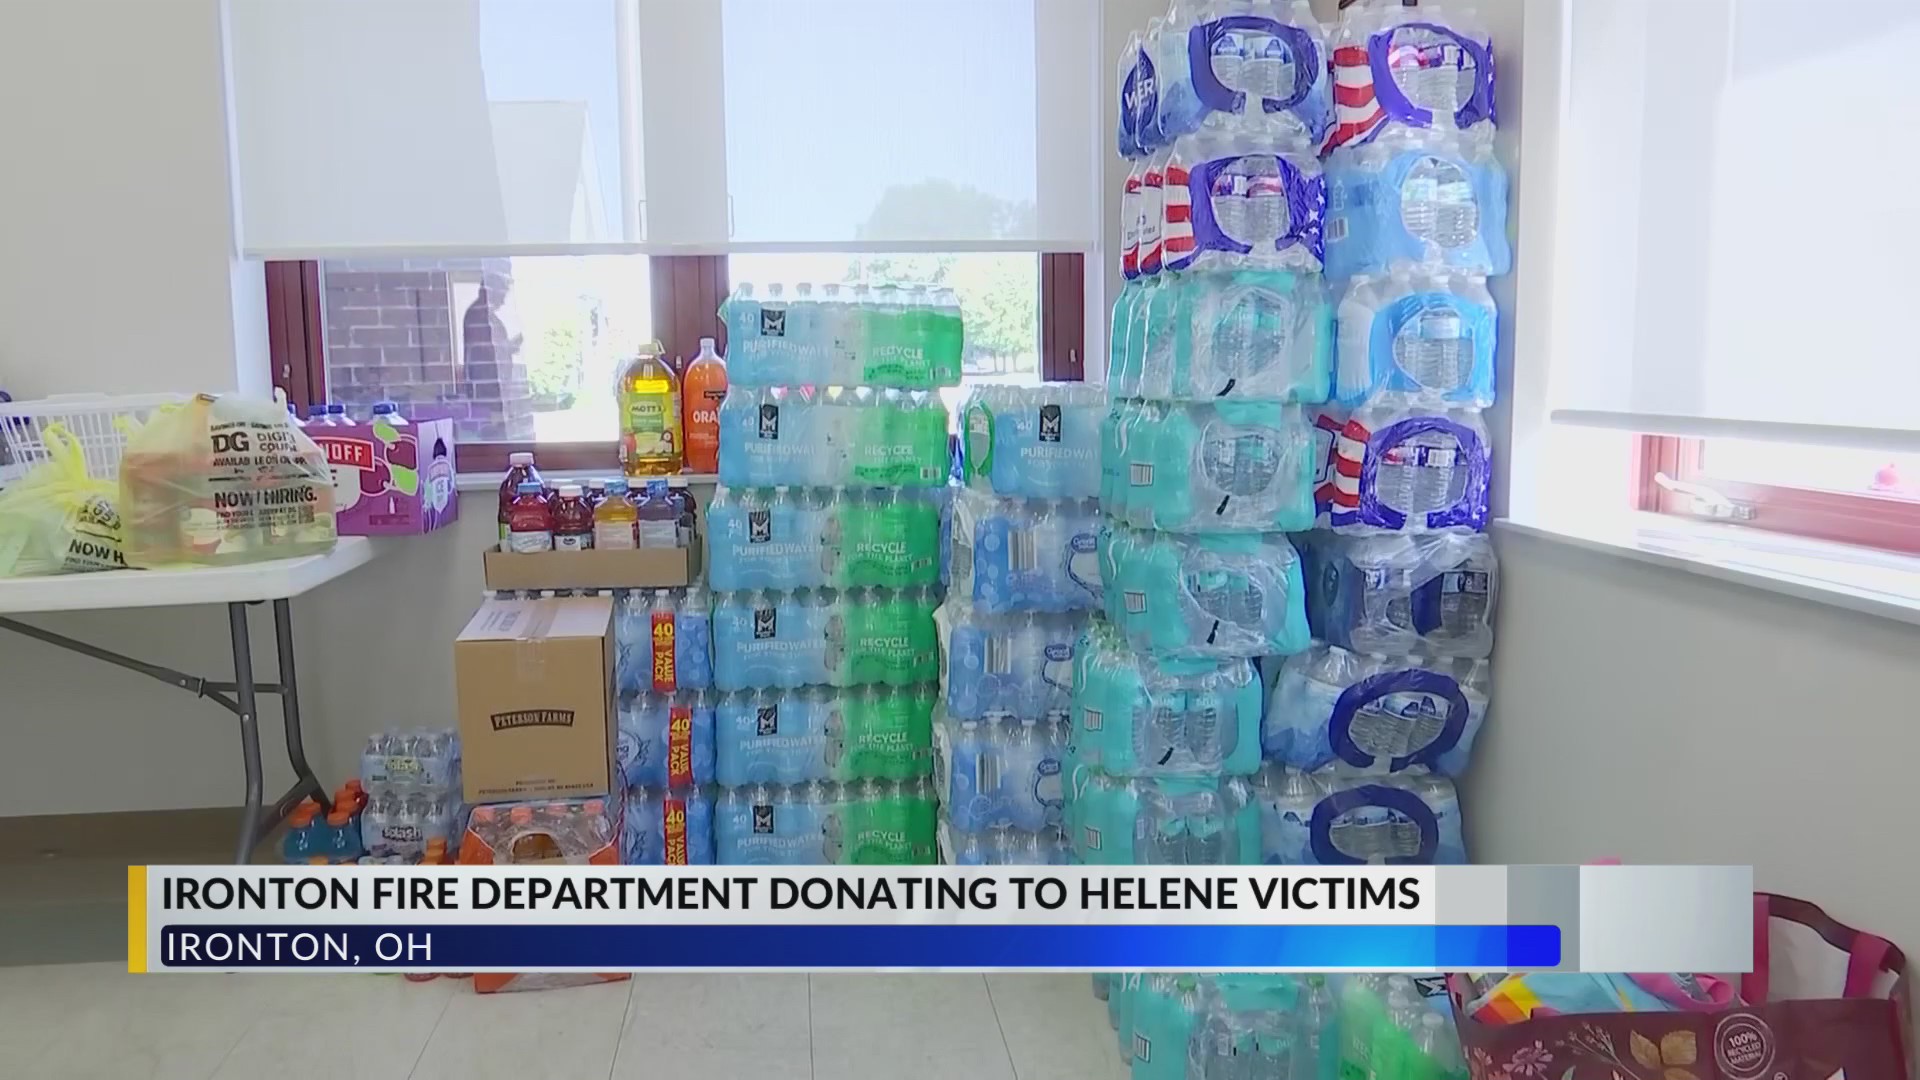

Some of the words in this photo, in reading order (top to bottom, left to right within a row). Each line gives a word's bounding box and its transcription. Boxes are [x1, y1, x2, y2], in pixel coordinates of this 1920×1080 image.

[211, 432, 250, 453] DG
[214, 492, 254, 508] NOW
[68, 539, 110, 560] NOW
[856, 541, 907, 554] RECYCLE
[653, 623, 674, 636] 40
[860, 637, 910, 648] RECYCLE
[654, 651, 664, 682] PACK
[664, 649, 674, 683] VALUE
[671, 718, 690, 732] 40
[859, 732, 908, 744] RECYCLE
[670, 746, 681, 777] PACK
[666, 810, 685, 824] 40
[857, 830, 906, 843] RECYCLE
[1728, 1031, 1758, 1048] 100%
